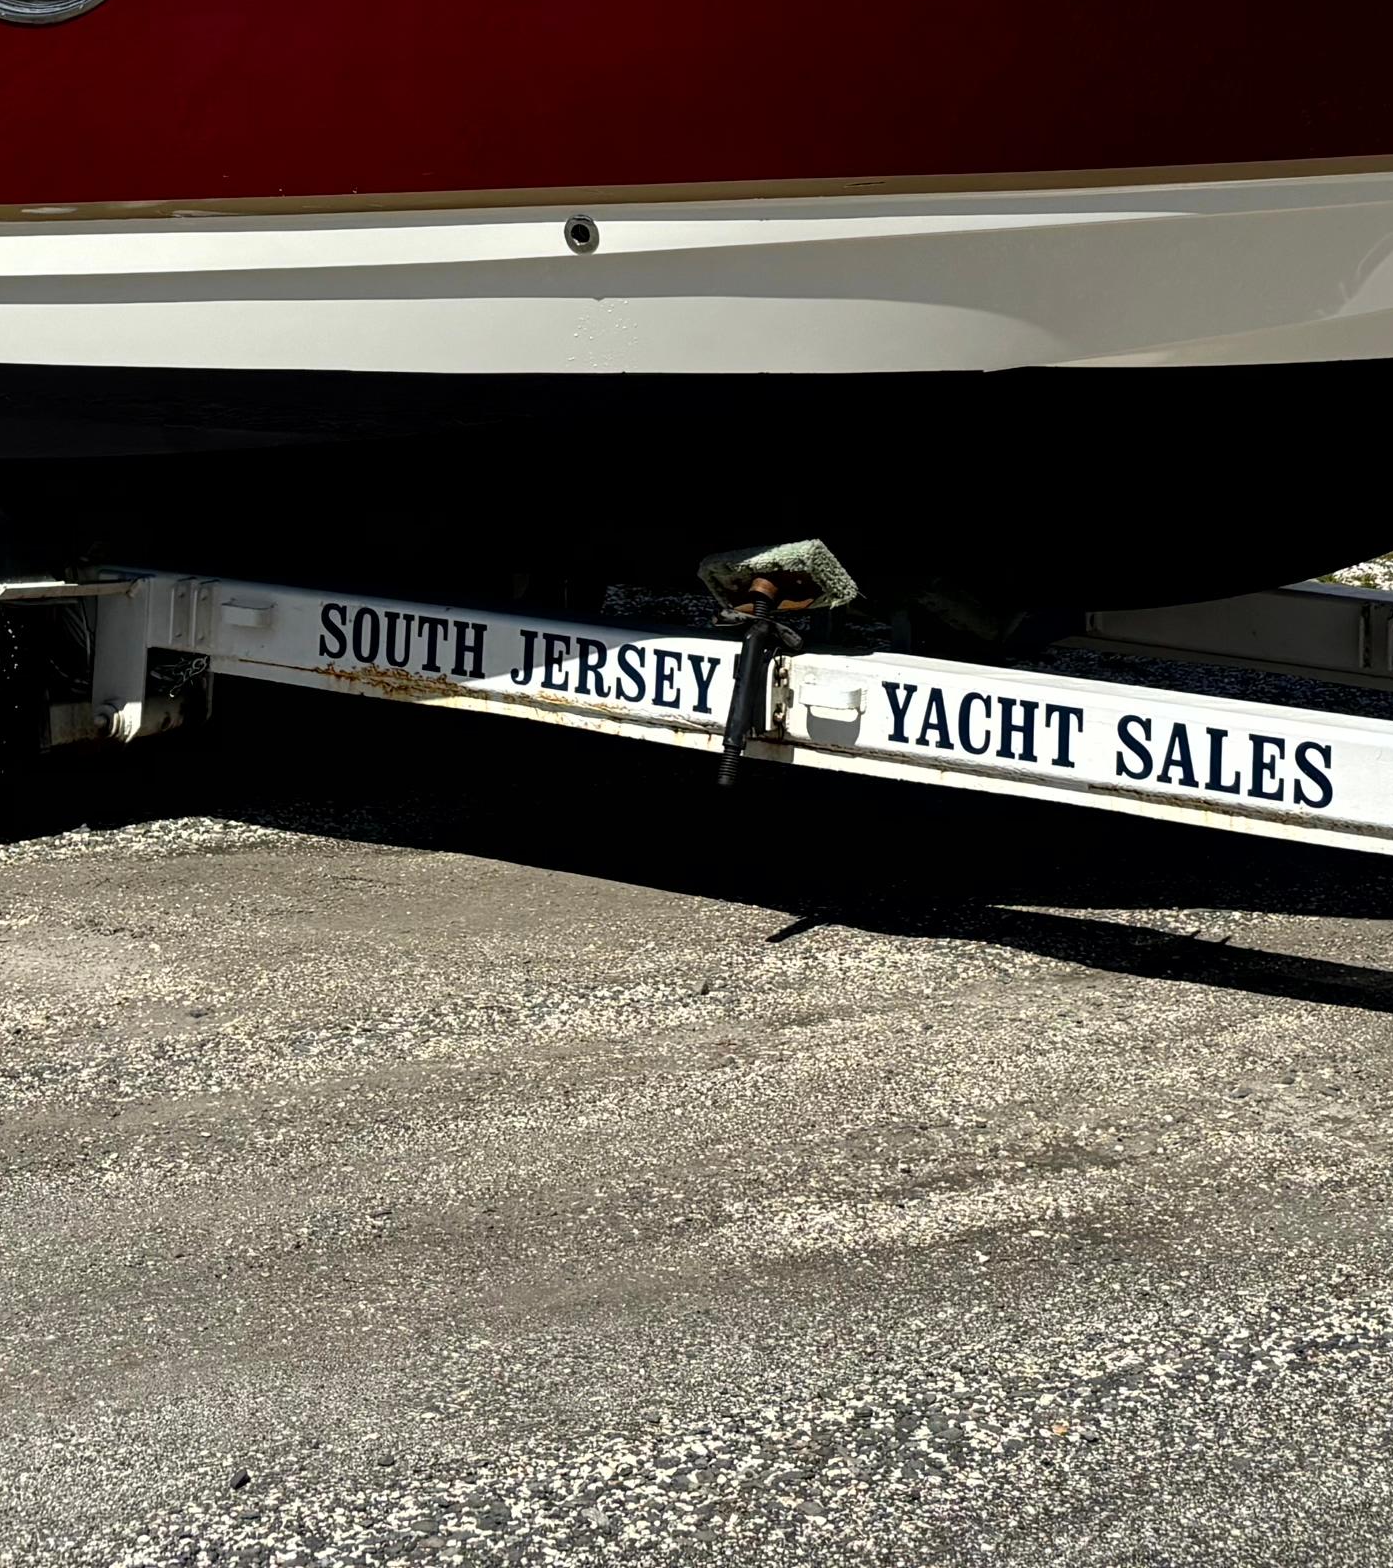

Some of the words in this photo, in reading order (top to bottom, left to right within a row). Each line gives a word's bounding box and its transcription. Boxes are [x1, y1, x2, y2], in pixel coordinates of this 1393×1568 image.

[318, 602, 488, 680] SOUTH
[510, 629, 721, 714] JERSEY
[882, 680, 1084, 768] YACHT
[1115, 715, 1334, 809] SALES
